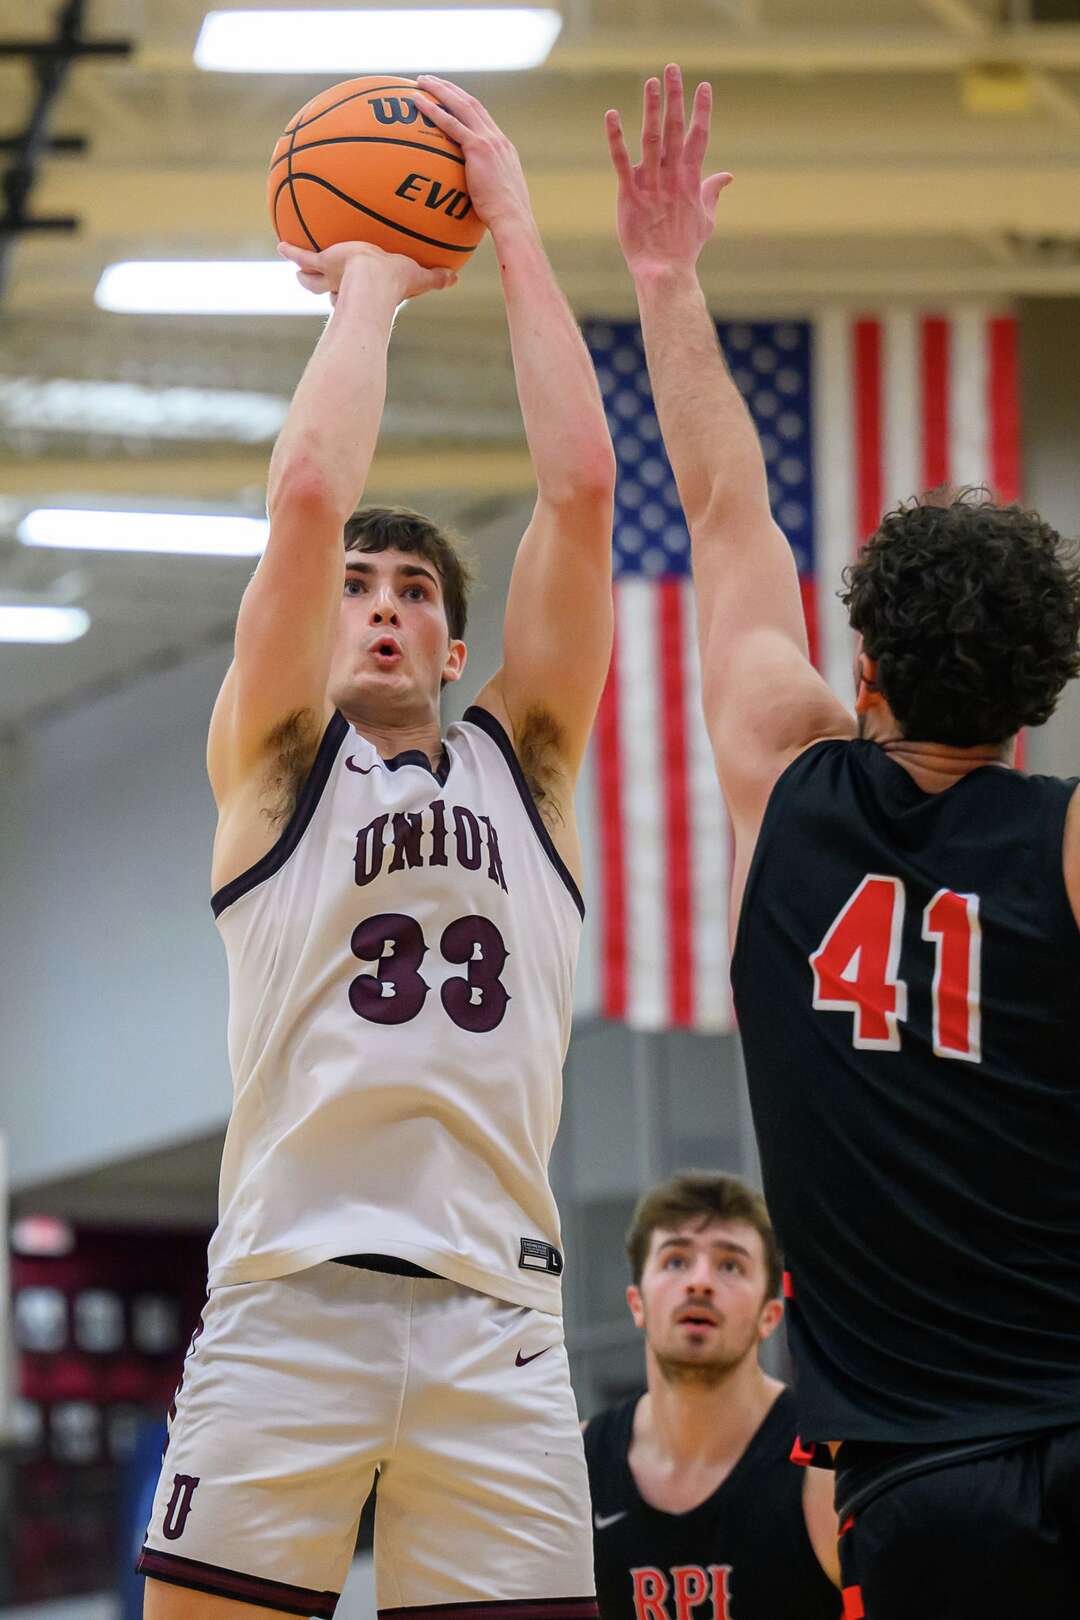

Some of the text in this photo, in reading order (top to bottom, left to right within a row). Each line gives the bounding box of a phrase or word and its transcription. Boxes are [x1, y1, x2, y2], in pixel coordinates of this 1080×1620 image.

[395, 173, 473, 220] EVO
[353, 800, 509, 895] UNION
[349, 913, 512, 1033] 33
[808, 873, 982, 1063] 41
[163, 1473, 200, 1540] U
[630, 1564, 733, 1620] RPI
